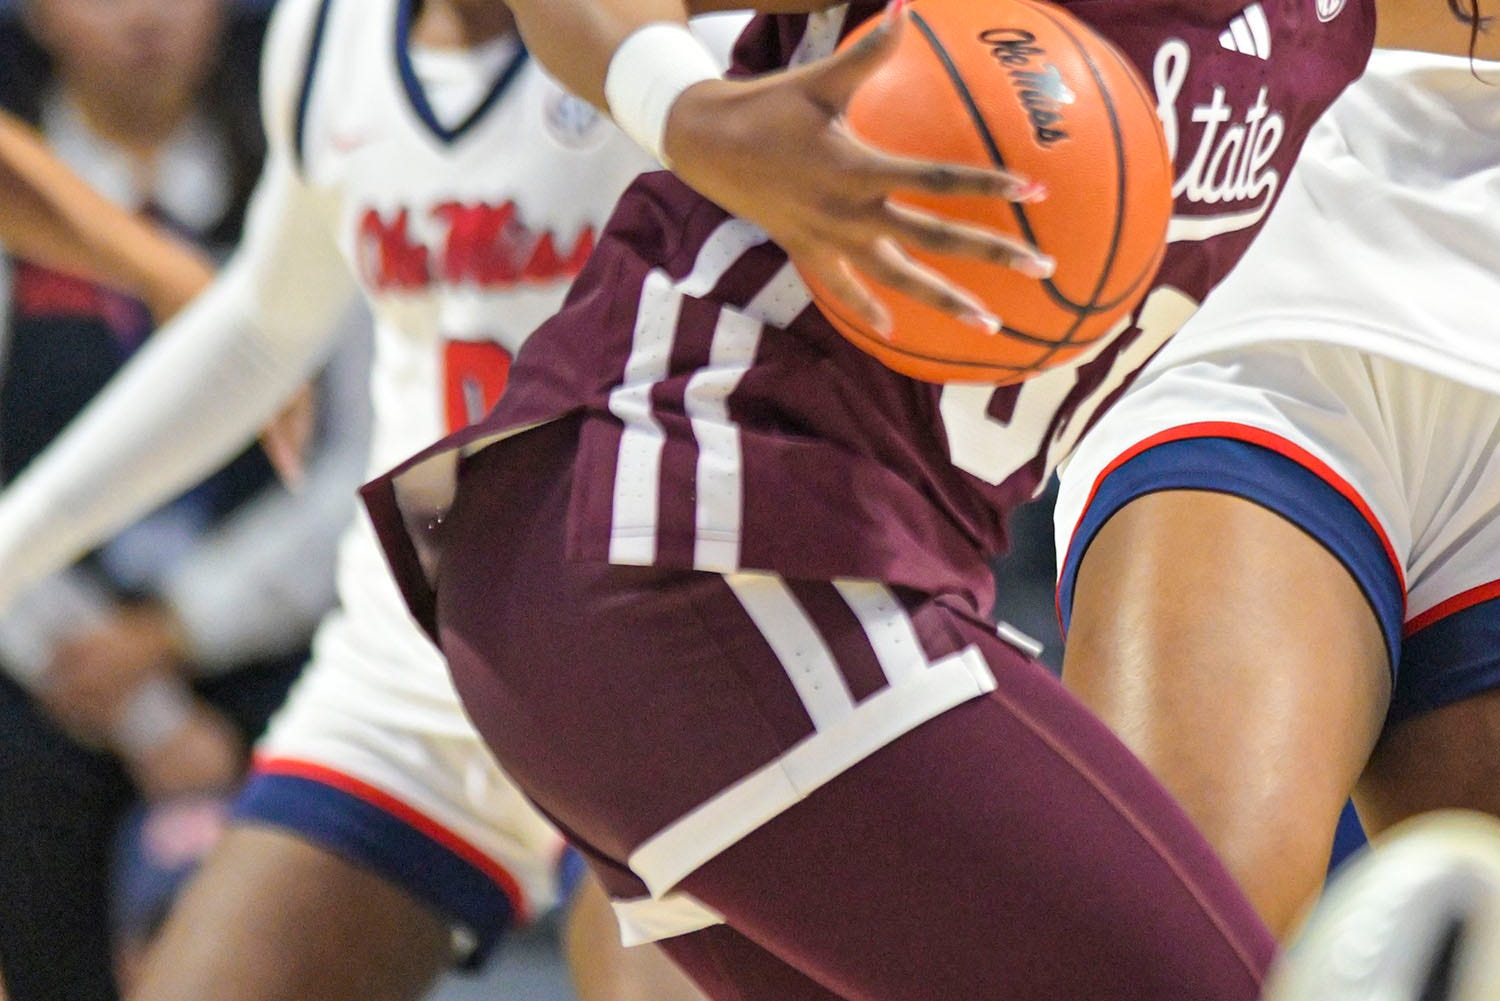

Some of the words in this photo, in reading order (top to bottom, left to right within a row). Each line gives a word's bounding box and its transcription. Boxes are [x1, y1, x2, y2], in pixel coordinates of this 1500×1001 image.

[977, 28, 1045, 68] Ole
[1009, 63, 1077, 149] Miss
[1153, 37, 1287, 215] State
